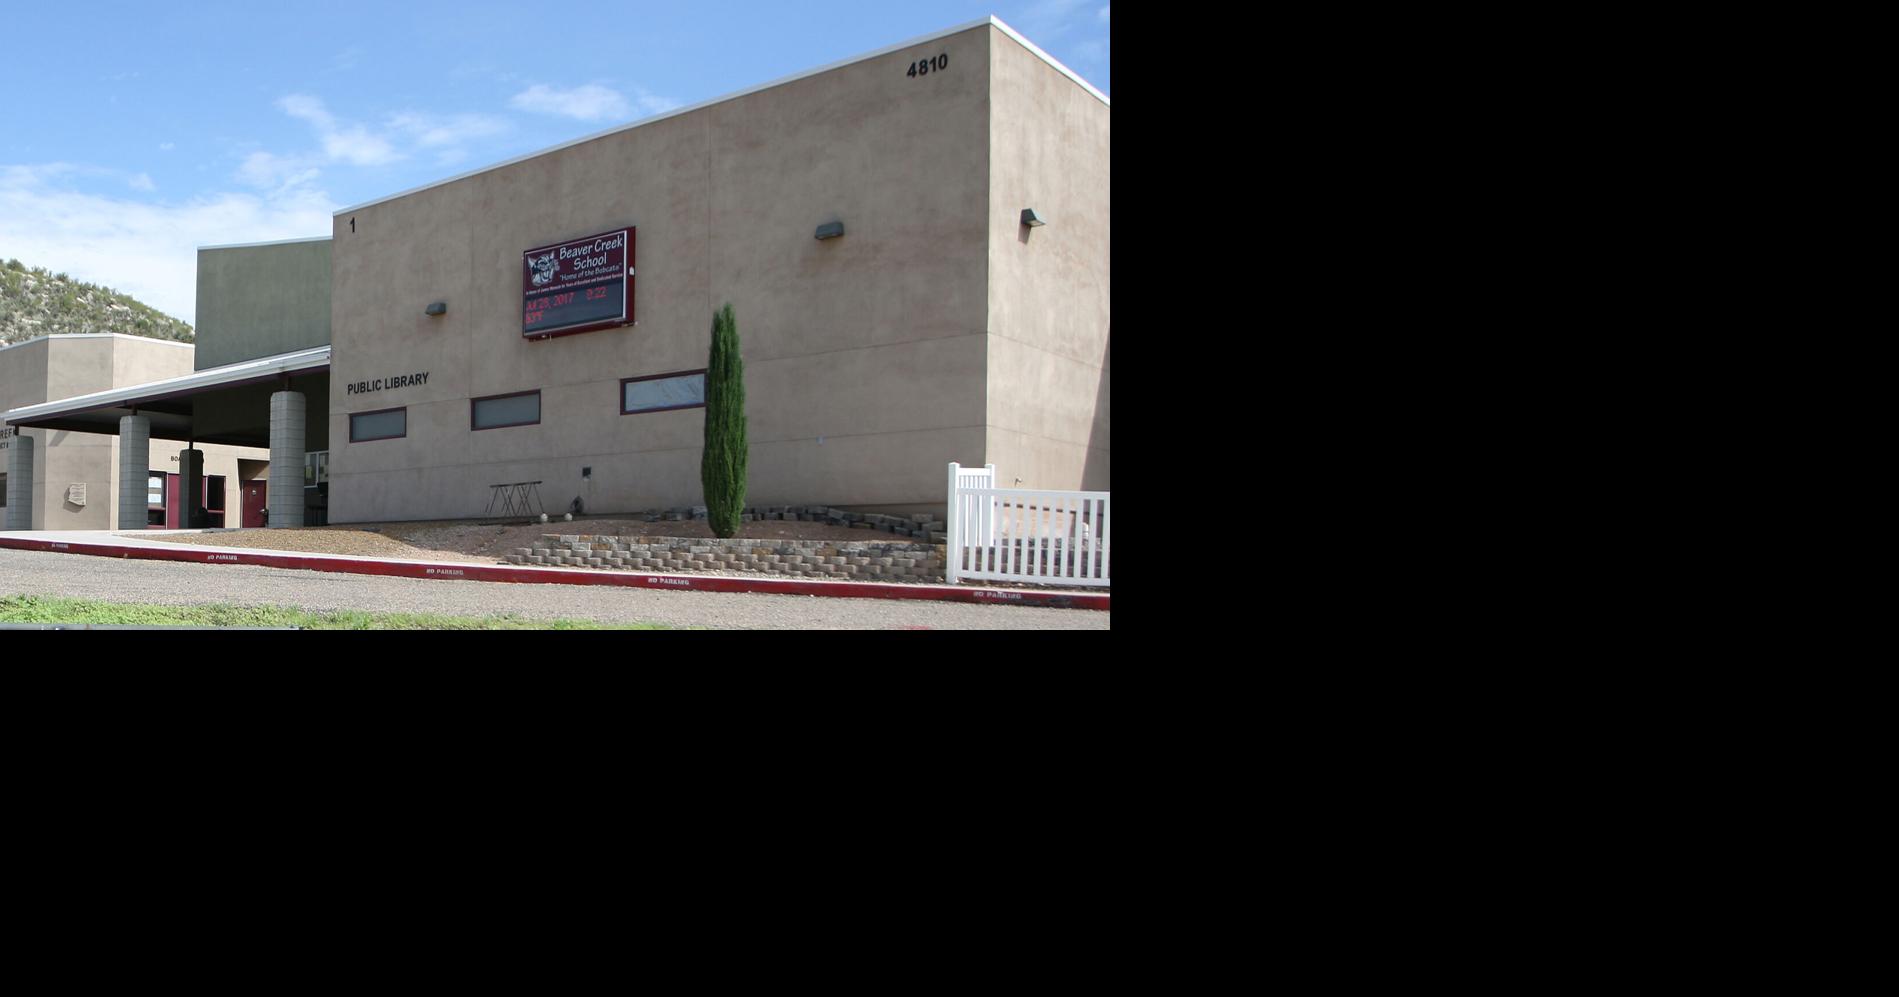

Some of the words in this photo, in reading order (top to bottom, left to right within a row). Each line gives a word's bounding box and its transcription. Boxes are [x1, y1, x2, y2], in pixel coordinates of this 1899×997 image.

[906, 53, 948, 78] 4810
[349, 216, 355, 233] 1
[559, 245, 593, 260] Beaver
[594, 235, 623, 252] Creek
[573, 252, 607, 271] School
[347, 379, 382, 396] PUBLIC
[384, 372, 429, 390] LIBRARY
[659, 577, 690, 585] PARKING
